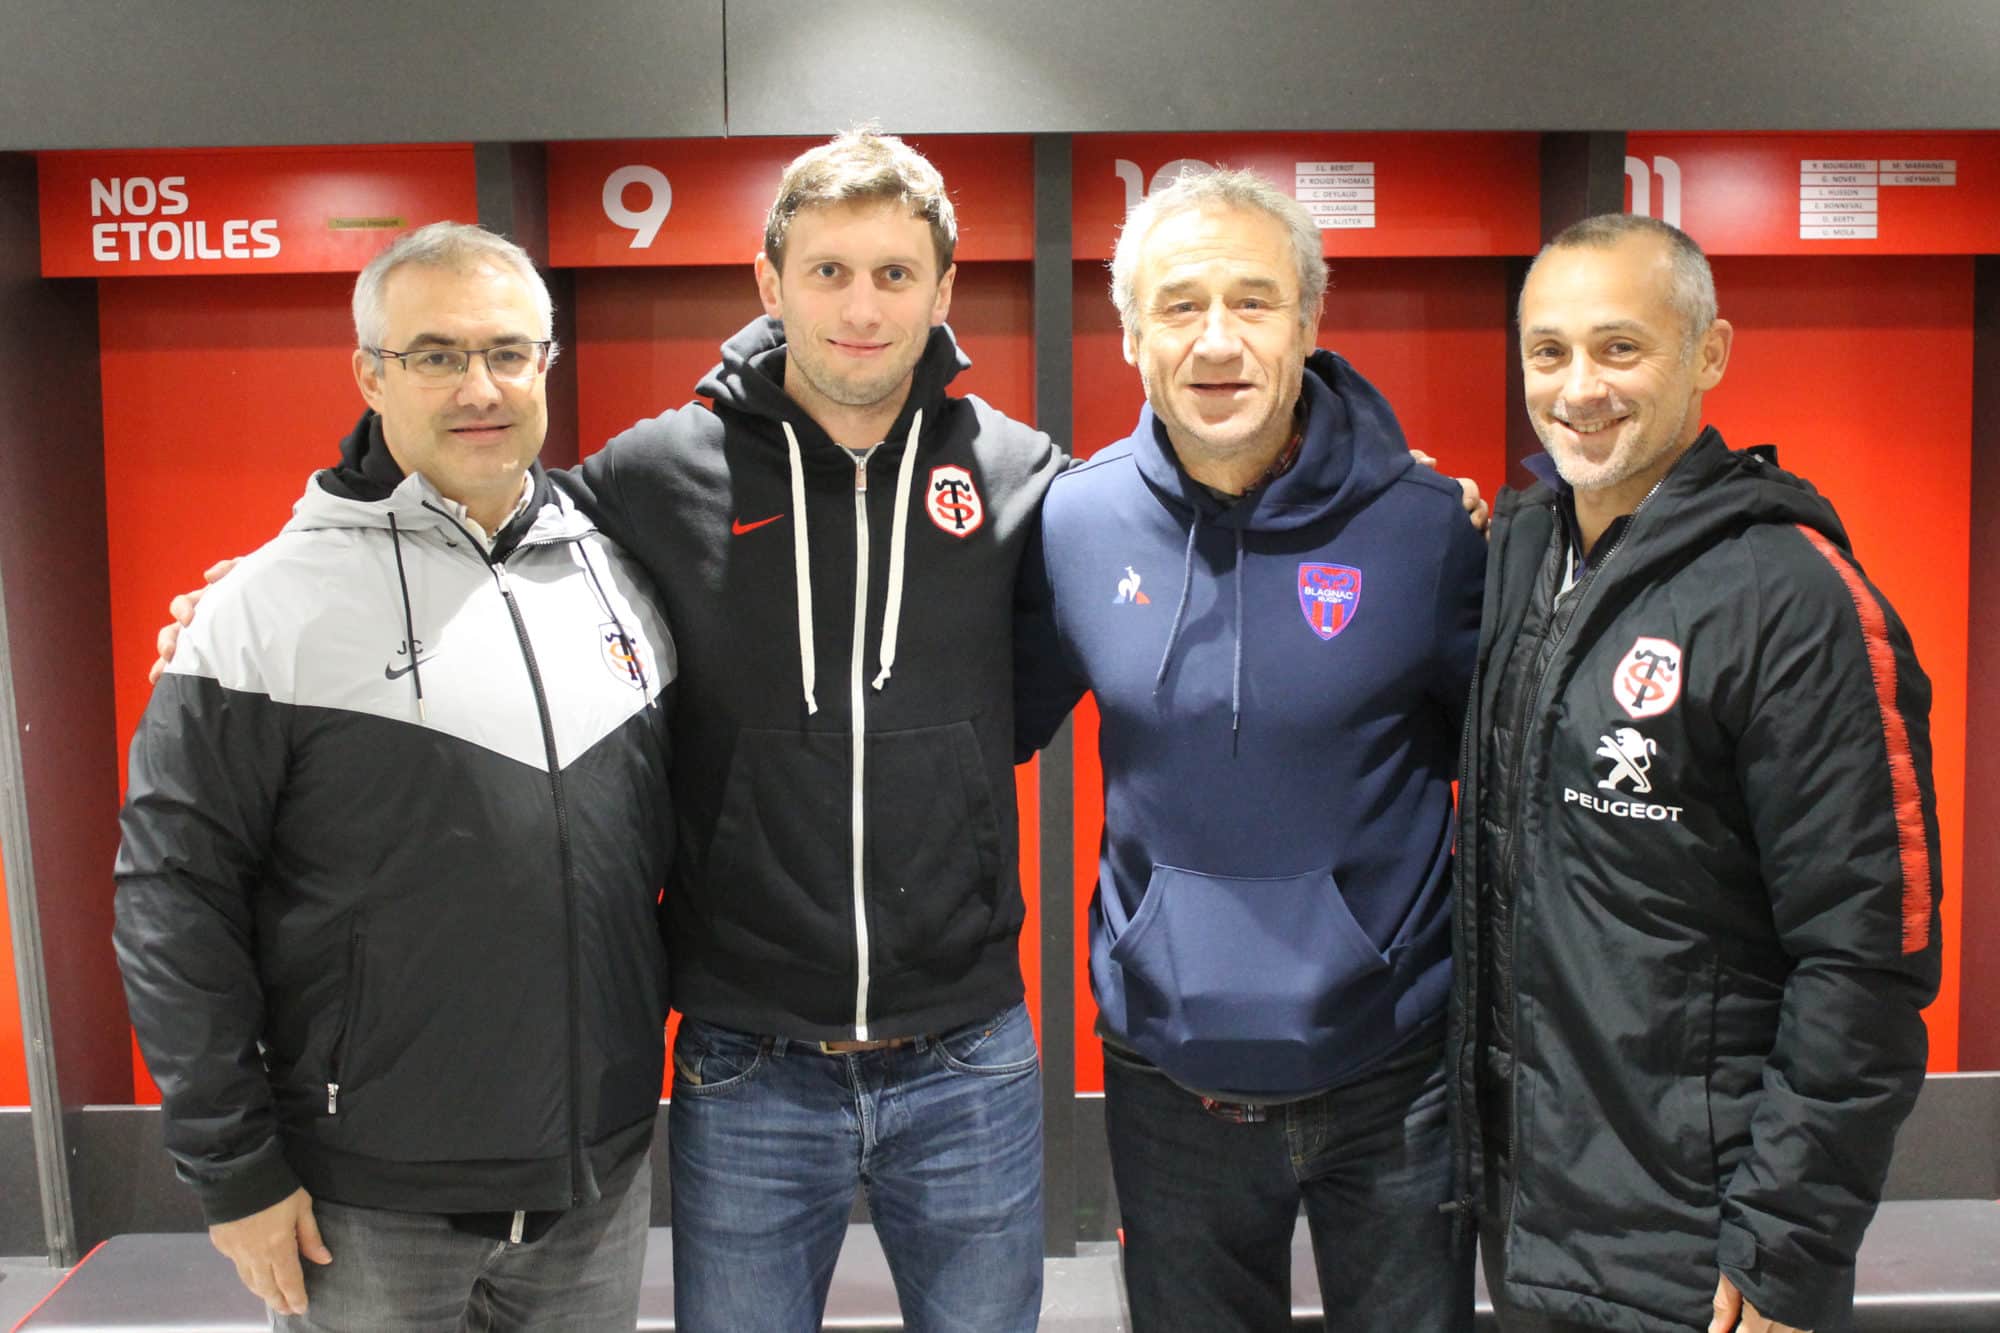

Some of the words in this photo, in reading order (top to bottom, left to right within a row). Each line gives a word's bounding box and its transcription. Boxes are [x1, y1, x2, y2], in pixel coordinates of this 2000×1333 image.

[90, 176, 189, 216] NOS
[602, 164, 672, 248] 9
[1624, 155, 1681, 228] 11
[92, 219, 281, 261] ETOILES
[1304, 586, 1353, 600] BLAGNAC
[1564, 787, 1683, 822] PEUGEOT
